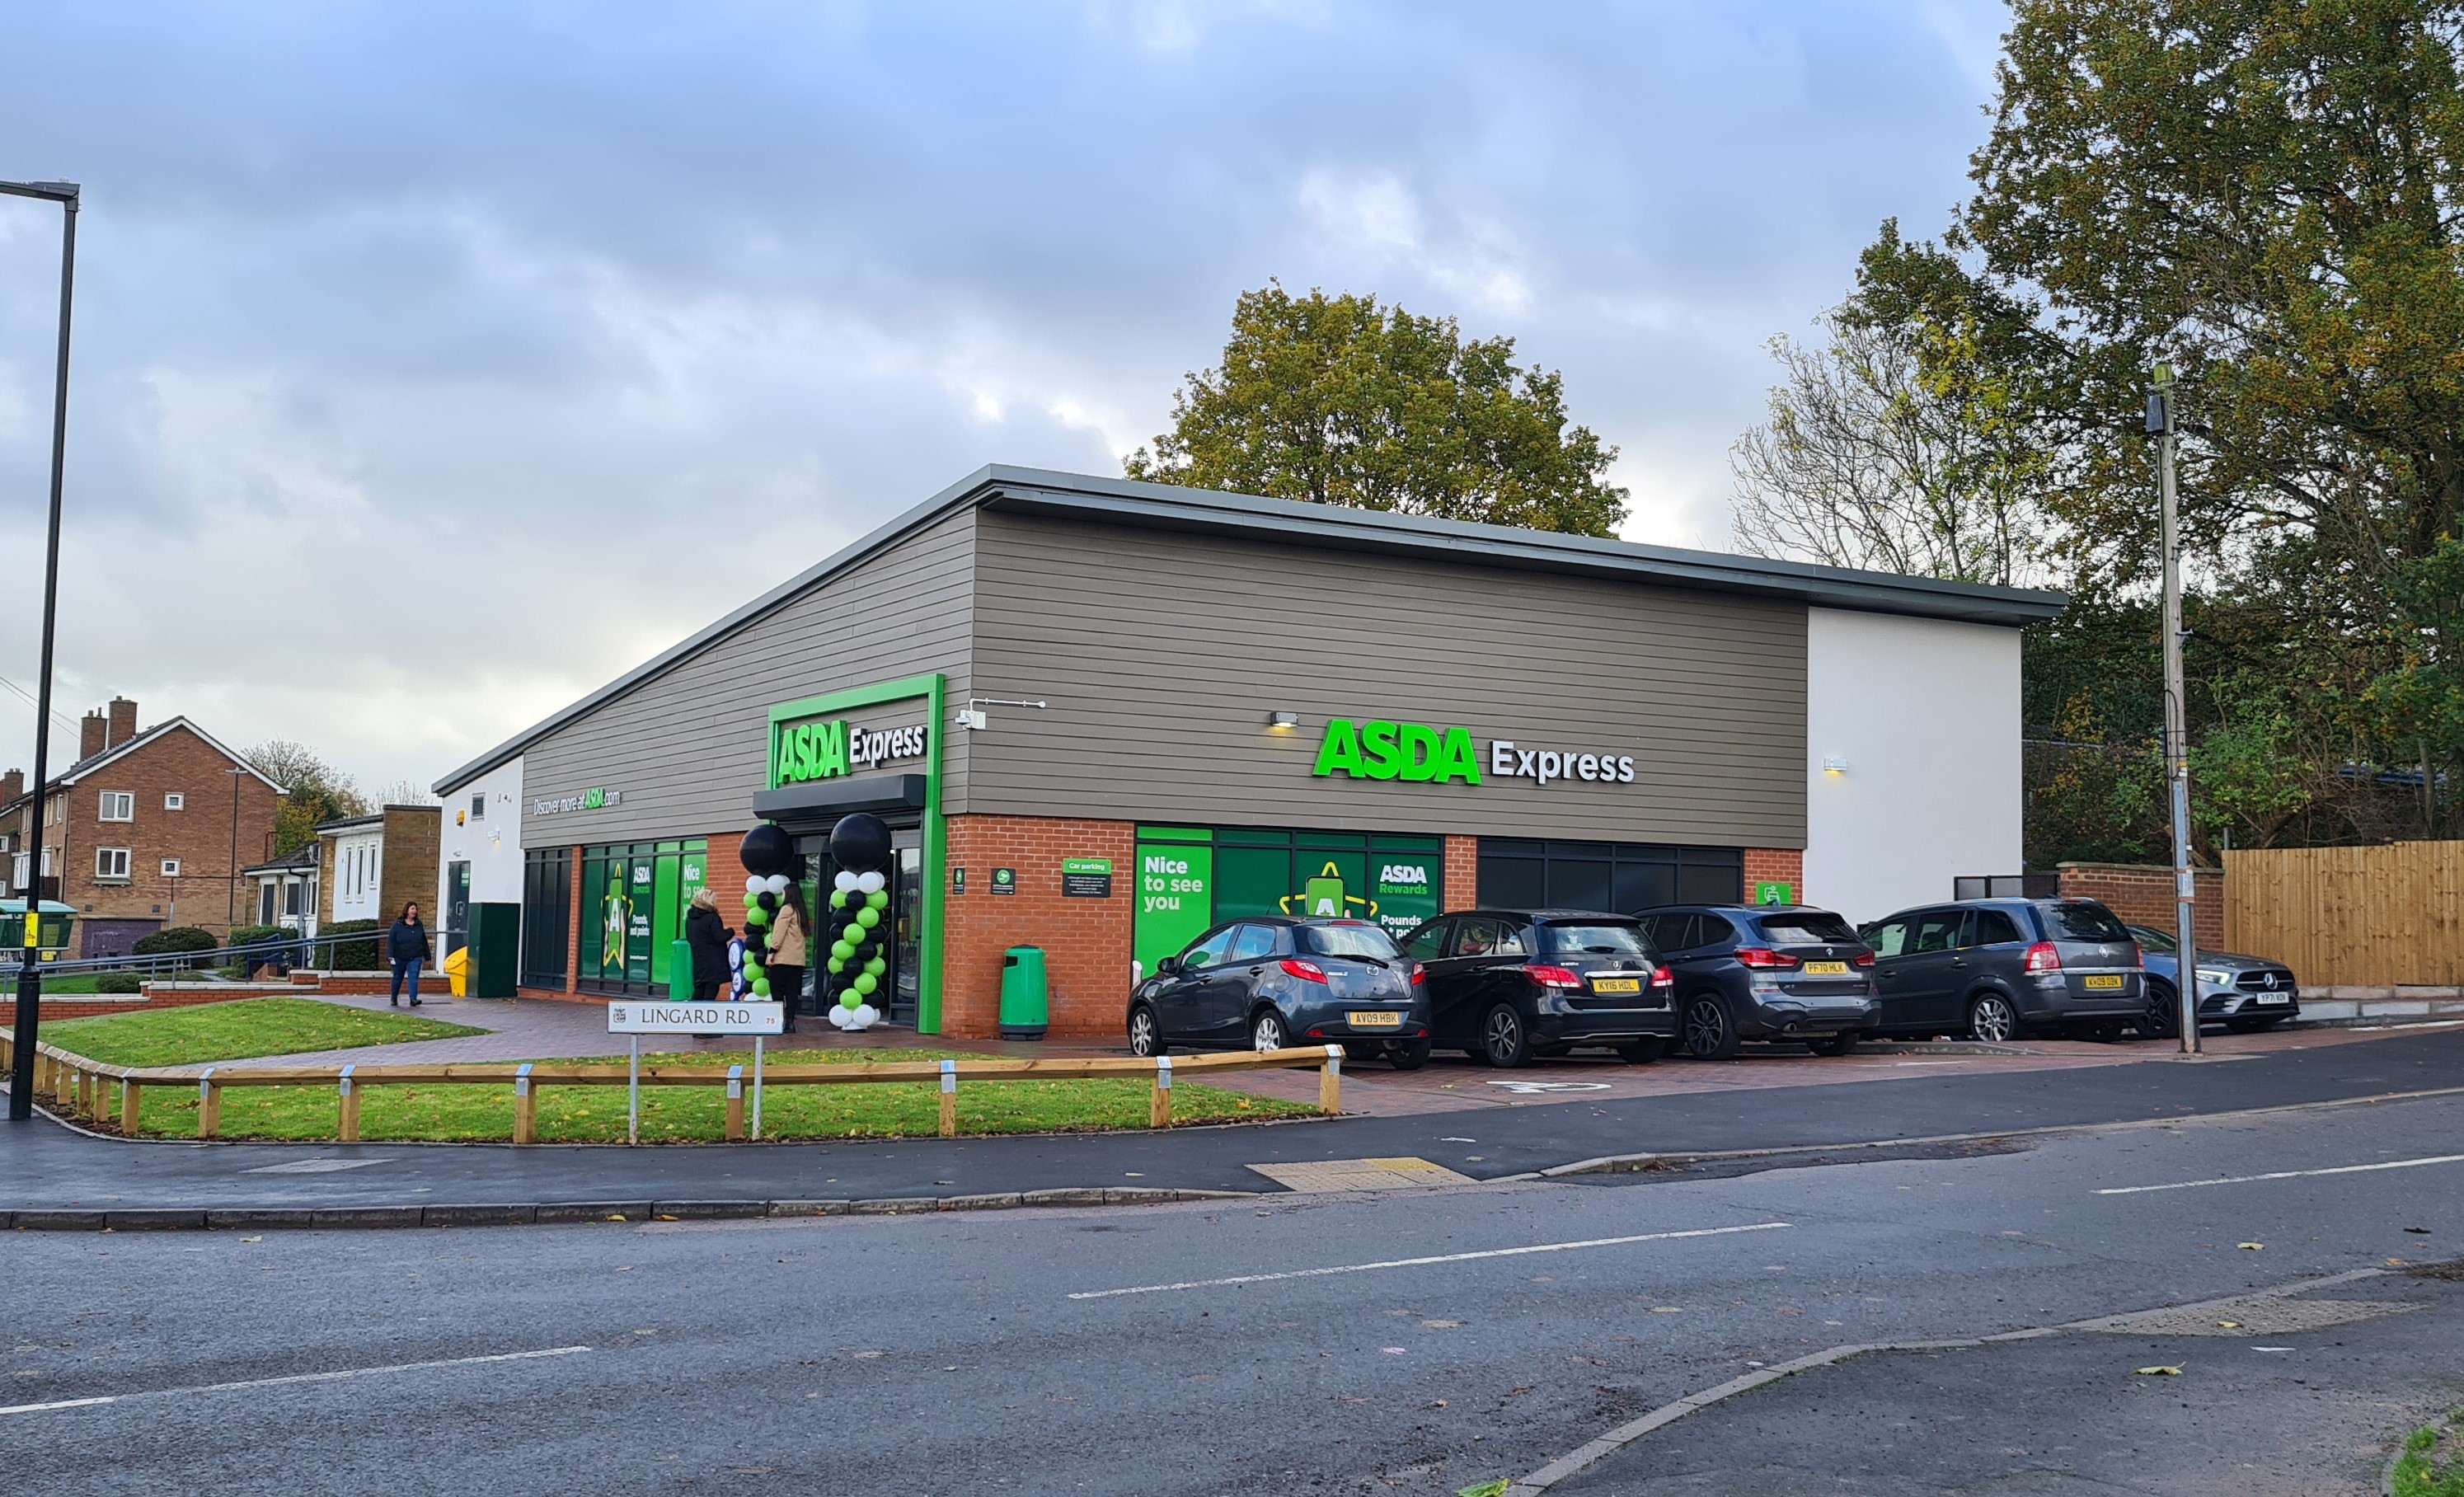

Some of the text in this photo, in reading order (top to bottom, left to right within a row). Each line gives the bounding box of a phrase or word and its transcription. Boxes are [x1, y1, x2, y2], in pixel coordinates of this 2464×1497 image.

[777, 720, 925, 783] ASDA Express
[1312, 719, 1635, 785] ASDA Express
[533, 799, 560, 815] Discover
[561, 796, 577, 812] more
[578, 793, 585, 810] at
[683, 864, 700, 881] Nice
[1081, 863, 1105, 871] parking
[1144, 856, 1188, 875] Nice
[633, 866, 651, 884] ASDA
[1379, 865, 1428, 884] ASDA
[683, 883, 692, 899] to
[1144, 875, 1204, 893] to see
[1379, 883, 1428, 895] Rewards
[1143, 896, 1180, 913] you
[1381, 914, 1423, 926] Pounds
[1808, 963, 1828, 973] PF70
[1598, 981, 1617, 991] KY16
[641, 1008, 719, 1025] LINGARD
[725, 1010, 752, 1024] RD.
[1355, 1014, 1397, 1023] AV09 HBK
